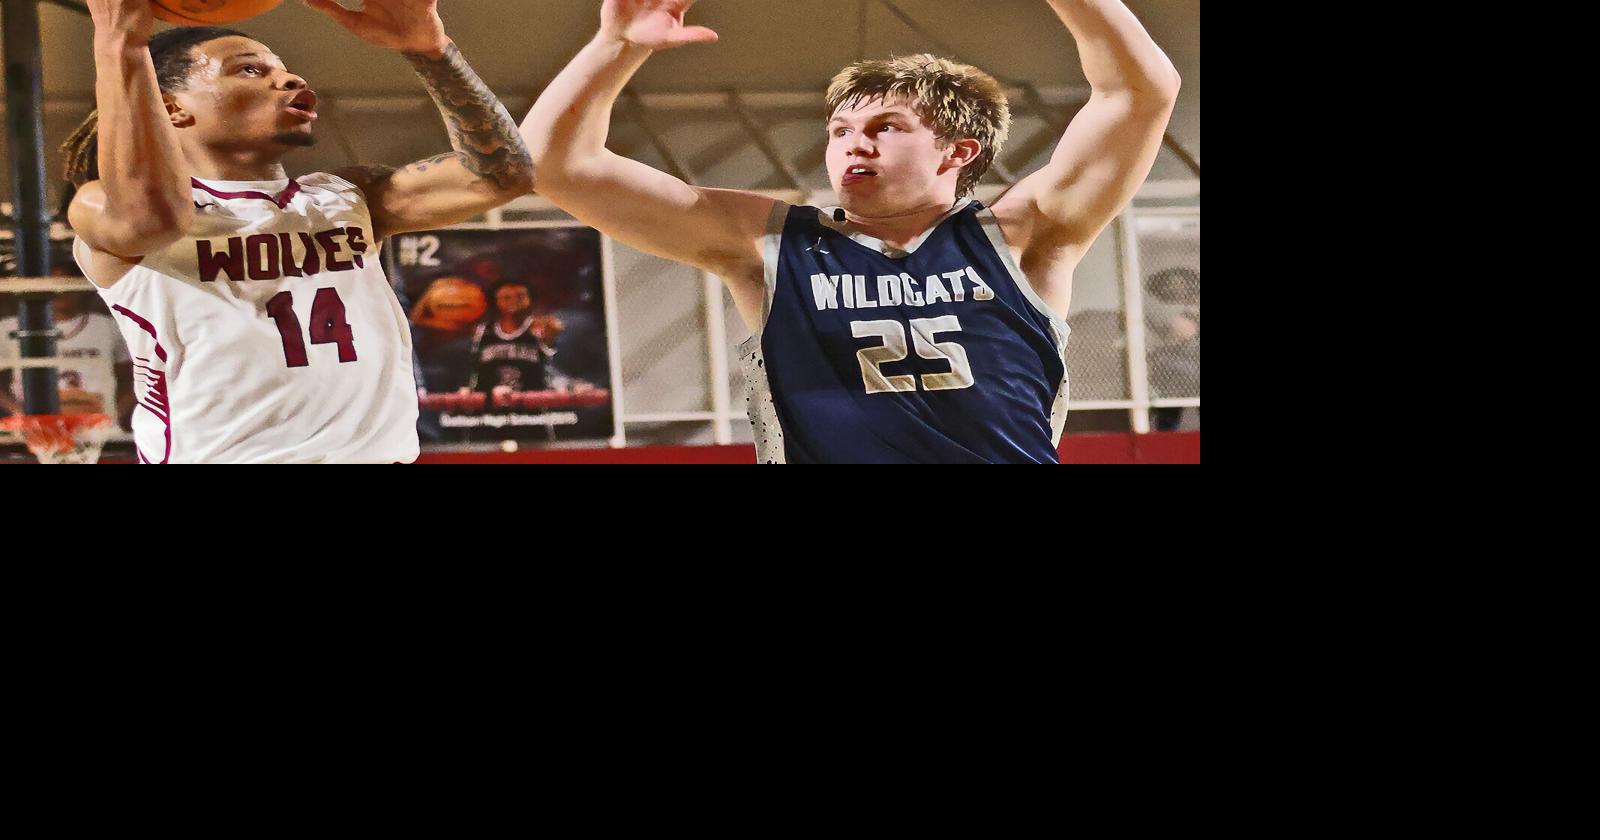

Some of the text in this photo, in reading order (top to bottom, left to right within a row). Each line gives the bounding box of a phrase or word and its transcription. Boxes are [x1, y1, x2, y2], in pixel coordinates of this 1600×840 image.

[196, 226, 368, 282] WOLVES
[400, 235, 441, 266] #2
[810, 265, 995, 311] WILDCATS
[265, 287, 358, 368] 14
[850, 315, 975, 394] 25
